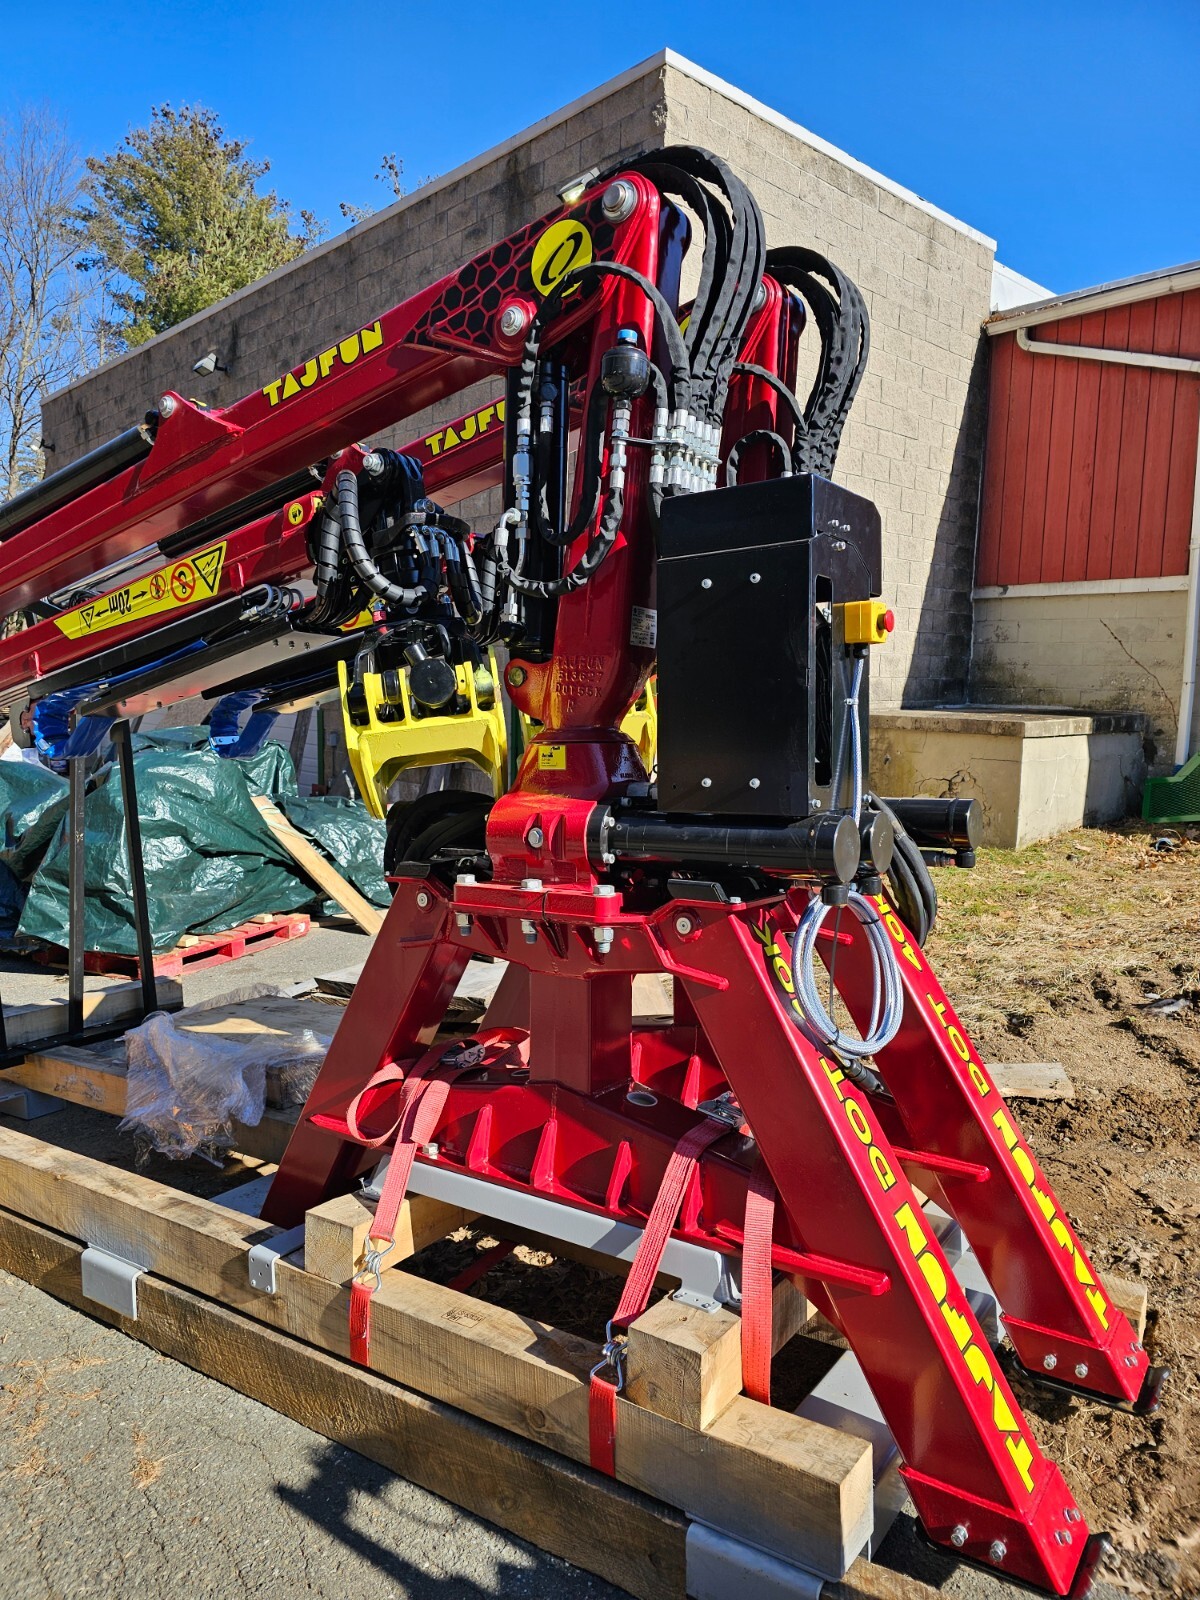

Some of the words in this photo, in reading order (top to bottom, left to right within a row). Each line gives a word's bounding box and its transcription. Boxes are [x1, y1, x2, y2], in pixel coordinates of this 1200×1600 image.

[263, 320, 384, 407] TAJFUN
[425, 400, 505, 456] TAJF
[108, 588, 132, 615] 20m
[926, 992, 991, 1097] DOT
[819, 1056, 897, 1193] DOT
[992, 1107, 1109, 1331] TAJFUN
[894, 1202, 1035, 1495] TAJFUN
